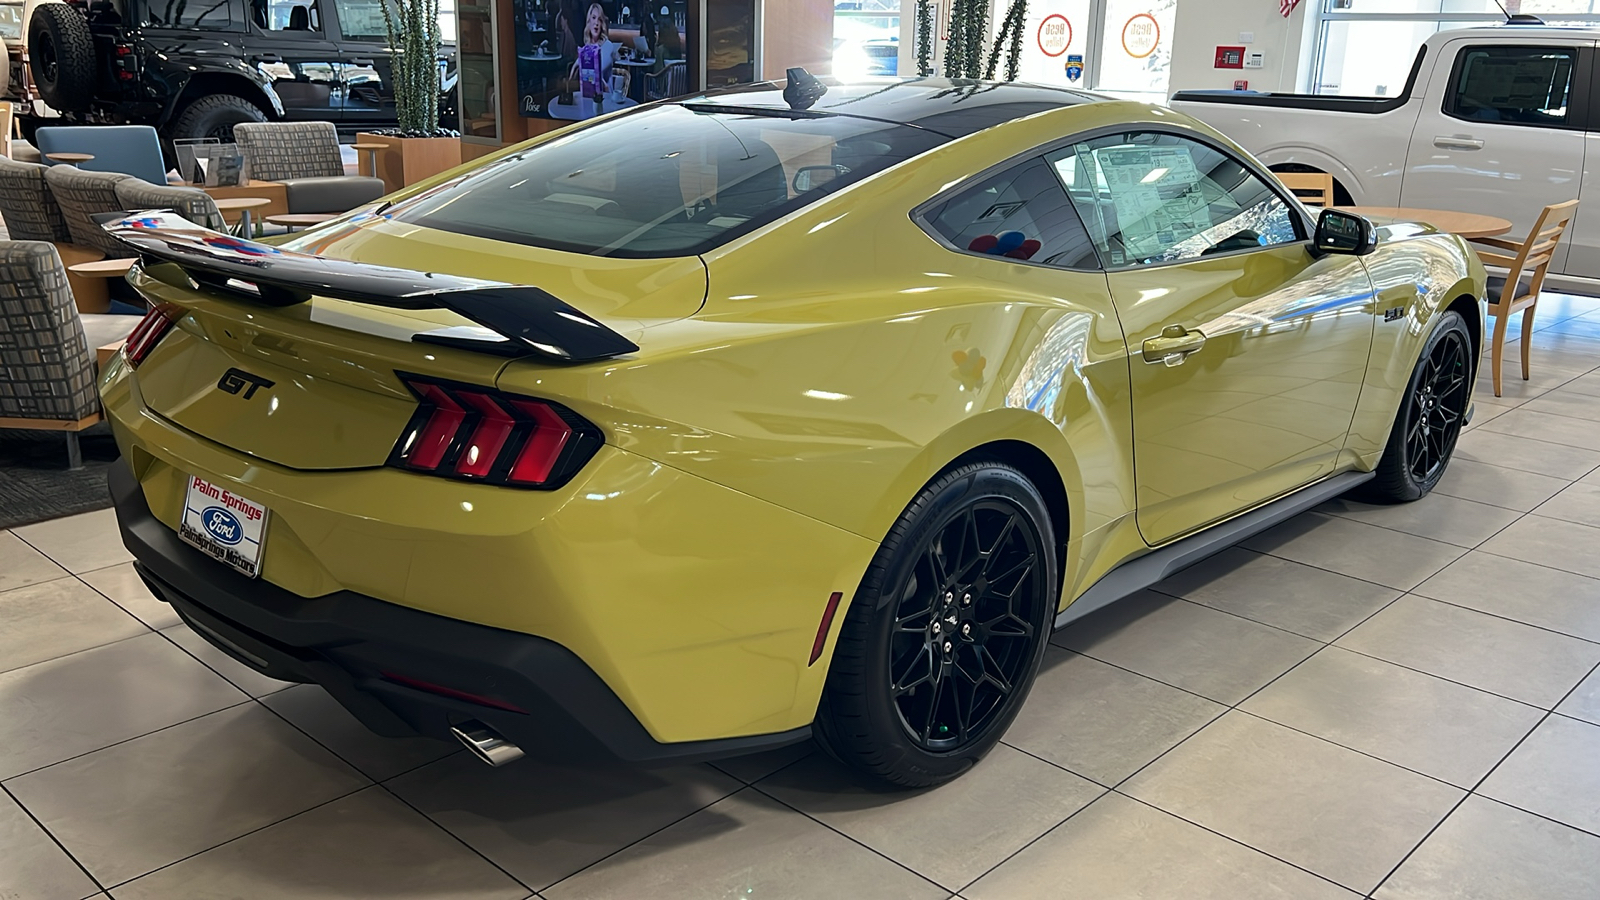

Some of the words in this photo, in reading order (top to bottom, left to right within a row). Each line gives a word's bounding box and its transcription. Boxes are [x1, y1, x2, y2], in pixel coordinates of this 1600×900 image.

[523, 94, 540, 112] Poise
[217, 367, 276, 400] GT
[192, 477, 220, 500] Palm
[220, 490, 263, 521] Springs
[208, 512, 236, 539] Ford
[225, 548, 256, 574] Motors
